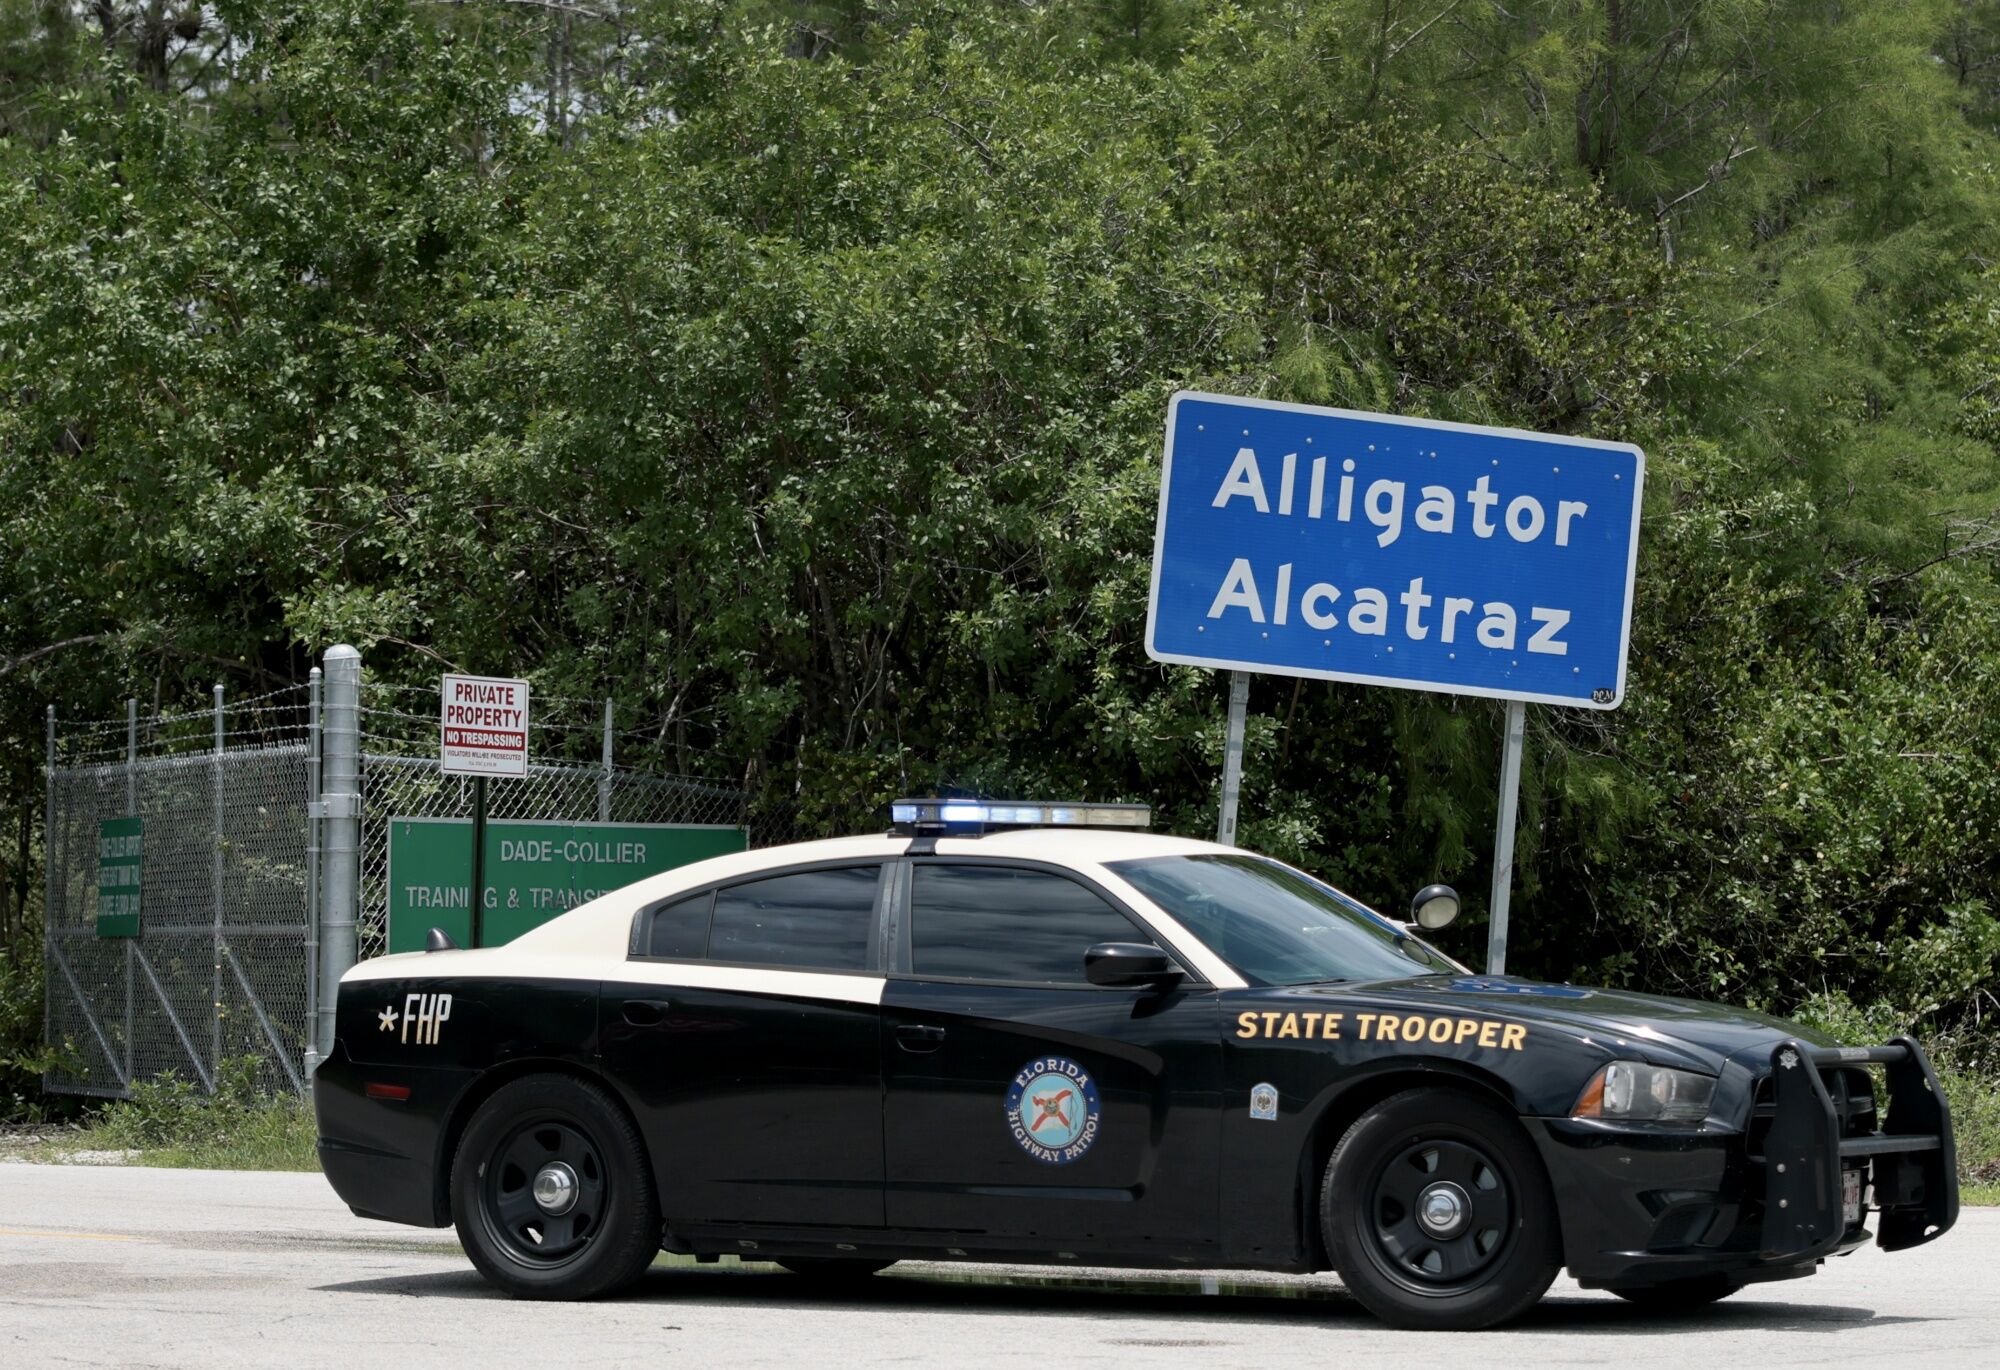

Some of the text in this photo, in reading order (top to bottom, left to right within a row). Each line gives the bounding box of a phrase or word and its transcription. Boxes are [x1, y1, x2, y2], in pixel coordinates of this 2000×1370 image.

[1212, 447, 1588, 548] Alligator
[1207, 558, 1571, 656] Alcatraz
[456, 683, 514, 705] PRIVATE
[448, 705, 521, 727] PROPERTY
[446, 731, 522, 746] NO TRESPASSING
[447, 750, 471, 758] VIOLATORS
[501, 840, 646, 863] DADE-COLLIER
[405, 886, 610, 910] TRAINIG & TRANS
[1236, 1012, 1527, 1050] STATE TROOPER
[1016, 1059, 1088, 1088] FLORIDA
[1008, 1108, 1098, 1162] HIGHWAY PATROL
